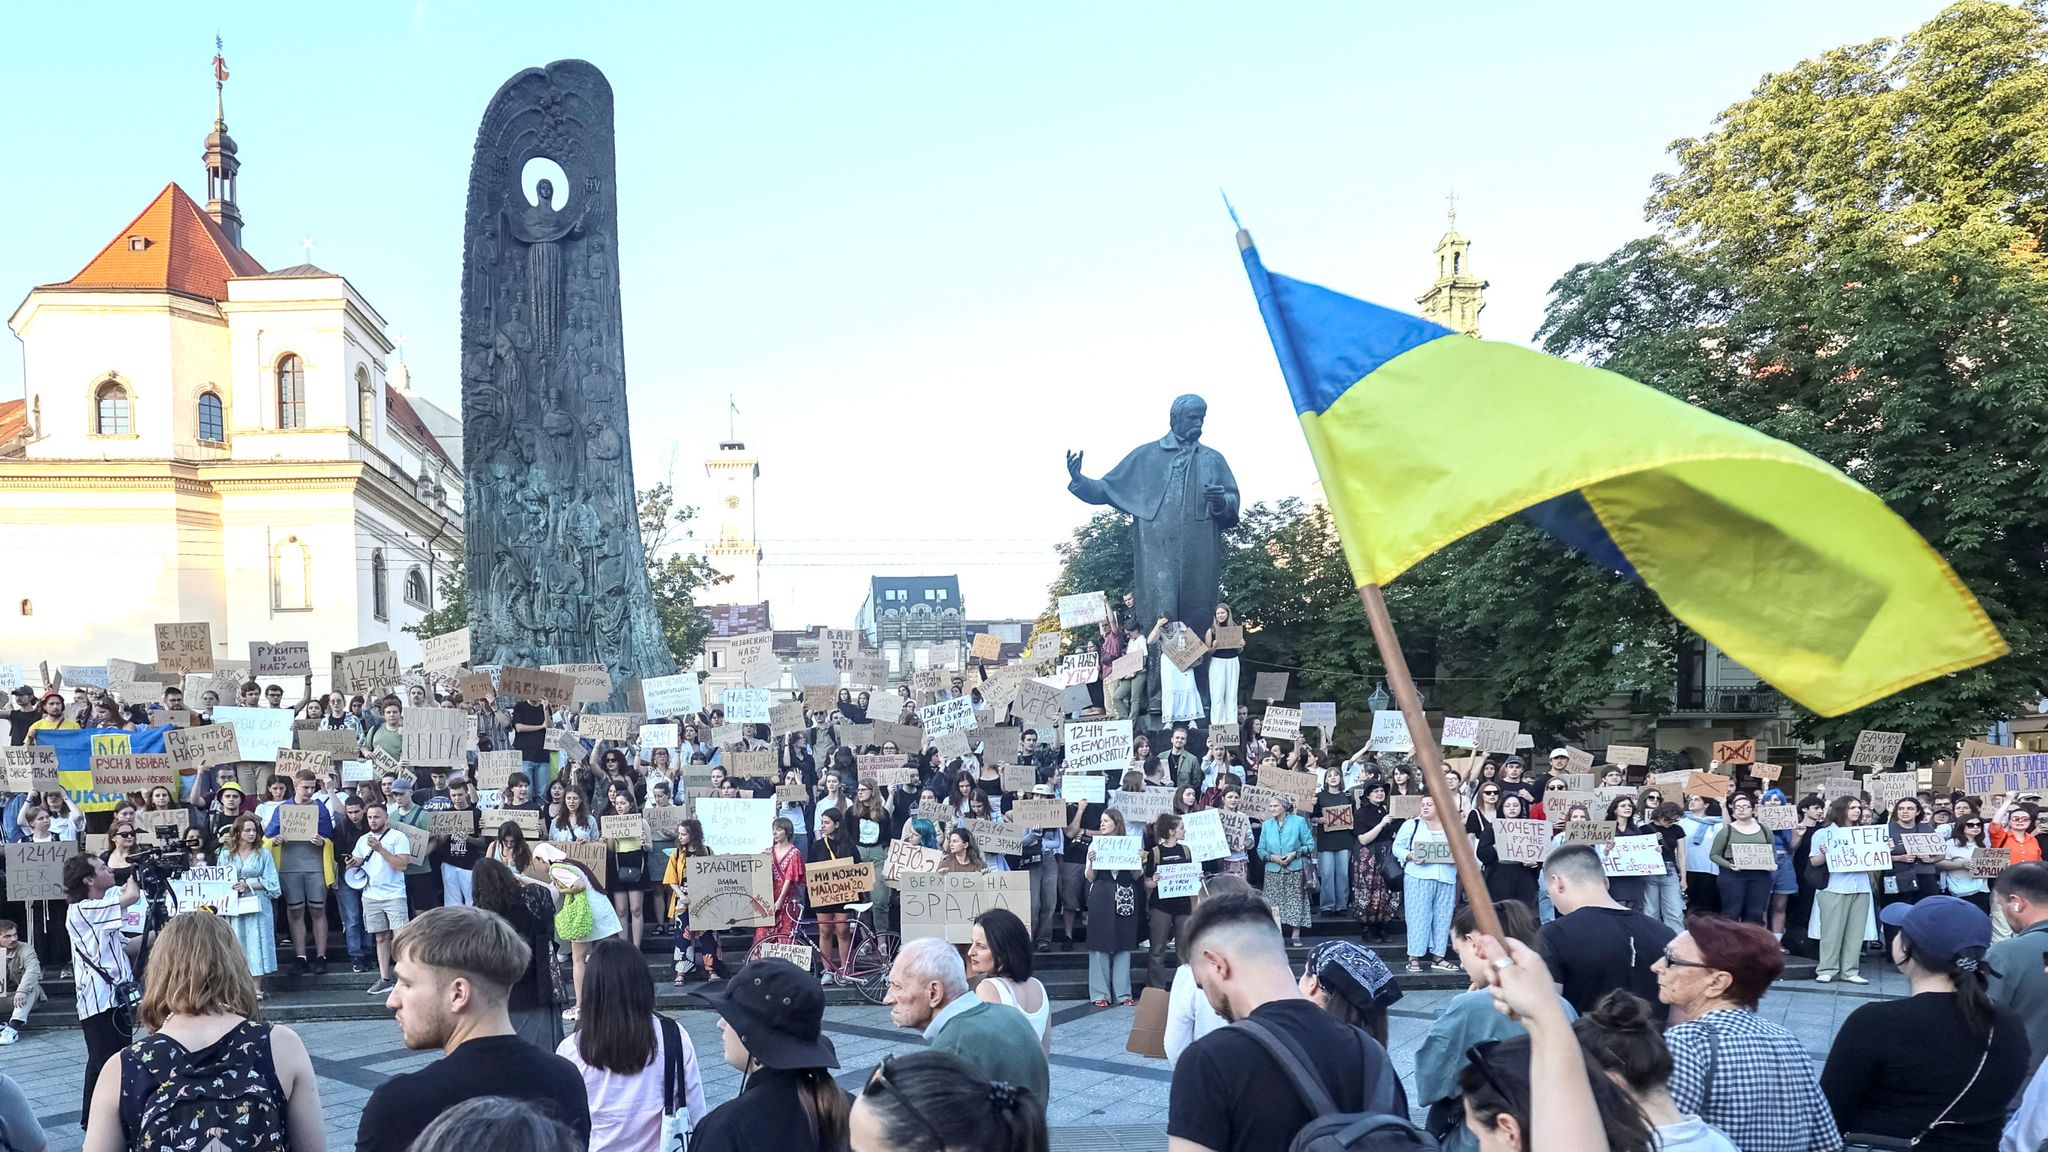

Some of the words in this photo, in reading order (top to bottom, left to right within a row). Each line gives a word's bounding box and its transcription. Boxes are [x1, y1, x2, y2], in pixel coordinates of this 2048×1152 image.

[158, 626, 168, 639] НЕ
[175, 626, 206, 639] НАБУ
[160, 641, 175, 651] ВАС
[180, 640, 205, 652] ЗНЕСЕ
[425, 637, 441, 651] ОП
[738, 645, 761, 657] НАБУ
[831, 640, 851, 651] ТУТ
[257, 646, 287, 657] РУКИ
[832, 650, 847, 659] НЕ
[161, 657, 181, 668] ТАК
[190, 657, 211, 668] МИ
[260, 662, 286, 671] НАБУ
[346, 654, 397, 681] 12414
[741, 656, 759, 665] САП
[1063, 656, 1075, 669] ЗА
[1077, 652, 1098, 668] НАБУ
[351, 679, 367, 692] НЕ
[402, 709, 468, 731] КОРУПЦІЯ
[923, 707, 936, 720] ВИ
[937, 706, 946, 717] НЕ
[585, 723, 624, 737] ЗРАДИ
[923, 718, 942, 729] ТЕСЬ
[1383, 717, 1403, 729] 12414
[1450, 719, 1473, 727] 12414
[1070, 725, 1104, 741] 12414
[1215, 733, 1239, 744] ГАНЬБА
[1444, 725, 1478, 739] ЗРАДА!
[1861, 731, 1903, 745] БАЧИМО
[1070, 735, 1129, 754] ДЕМОНТАЖ
[1374, 736, 1393, 745] НОМЕР
[173, 743, 205, 763] НАБУ
[1879, 745, 1897, 755] ХТО
[39, 751, 54, 764] ВАС
[95, 758, 132, 771] РУСНЯ
[135, 757, 171, 770] ВБИВАЄ
[279, 750, 310, 762] НАБУ
[314, 754, 332, 767] САП
[859, 757, 868, 765] ЦЕ
[1965, 756, 2009, 776] БУДЬ-ЯКА
[95, 775, 121, 785] ВЛАСНА
[1259, 769, 1309, 788] КОРУПЦІЯ
[1967, 775, 1994, 793] ТЕПЕР
[2004, 772, 2019, 791] ПІД
[282, 810, 311, 821] ВЛАДА
[1761, 806, 1793, 818] 12414
[1498, 820, 1545, 837] ХОЧЕТЕ
[1580, 830, 1612, 841] ЗРАДИ
[996, 836, 1023, 851] ЗРАДИ
[1512, 835, 1544, 845] РУЧНЕ
[1851, 828, 1889, 845] ГЕТЬ
[1095, 837, 1132, 851] 12414
[17, 846, 67, 864] 12414
[1506, 844, 1544, 859] НАБУ
[1604, 857, 1625, 873] НЕ
[1863, 851, 1890, 867] САП
[1975, 857, 2003, 867] НОМЕР
[176, 865, 234, 882] МОКРАТІЯ?
[695, 860, 763, 875] ЗРАДОМЕТР
[832, 866, 869, 882] МОЖЕМО
[1165, 865, 1176, 874] НЕ
[1973, 866, 2004, 876] ЗРАДИ
[811, 882, 851, 897] МАЙДАН
[1162, 884, 1193, 893] ЯНИКА
[820, 890, 857, 904] ХОЧЕТЕ?
